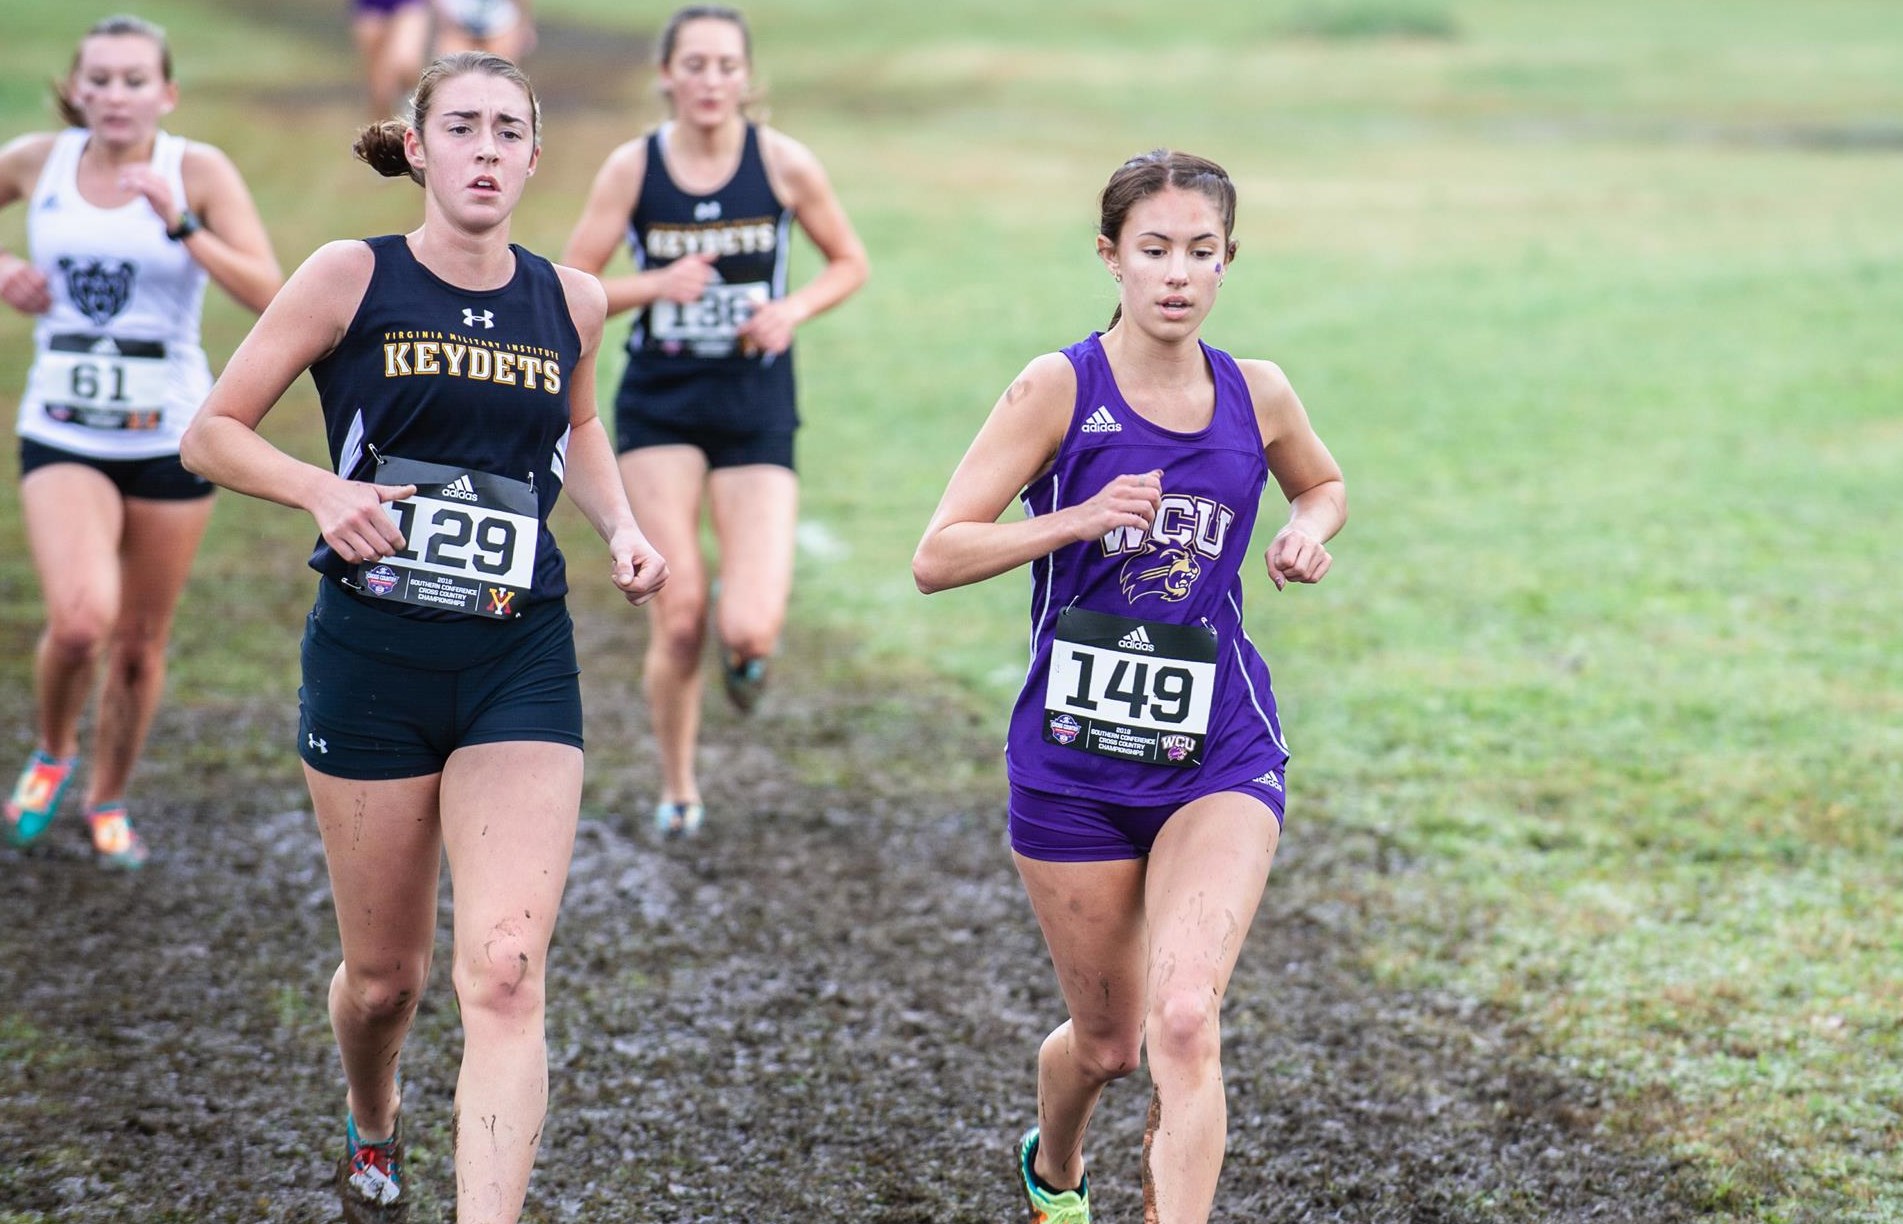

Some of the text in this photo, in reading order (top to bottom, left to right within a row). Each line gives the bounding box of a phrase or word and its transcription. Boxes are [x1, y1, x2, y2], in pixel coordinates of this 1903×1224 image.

[384, 330, 560, 361] VIRGINIA MILITARY INSTITUTE
[383, 341, 561, 395] KEYDETS
[71, 363, 128, 401] 61
[1081, 421, 1123, 433] adidas
[441, 488, 479, 502] adidas
[391, 500, 517, 576] 129
[410, 578, 478, 596] SOUTHERN CONFERENCE
[418, 587, 467, 600] CROSS COUNTRY
[417, 593, 466, 607] CHAMPIONSHIPS
[1118, 638, 1155, 652] adidas
[1065, 650, 1194, 724] 149
[1090, 728, 1156, 745] SOUTHERN CONFERENCE
[1098, 736, 1146, 750] CROSS COUNTRY
[1160, 734, 1197, 752] WCU
[1098, 743, 1144, 757] CHAMPIONSHIPS
